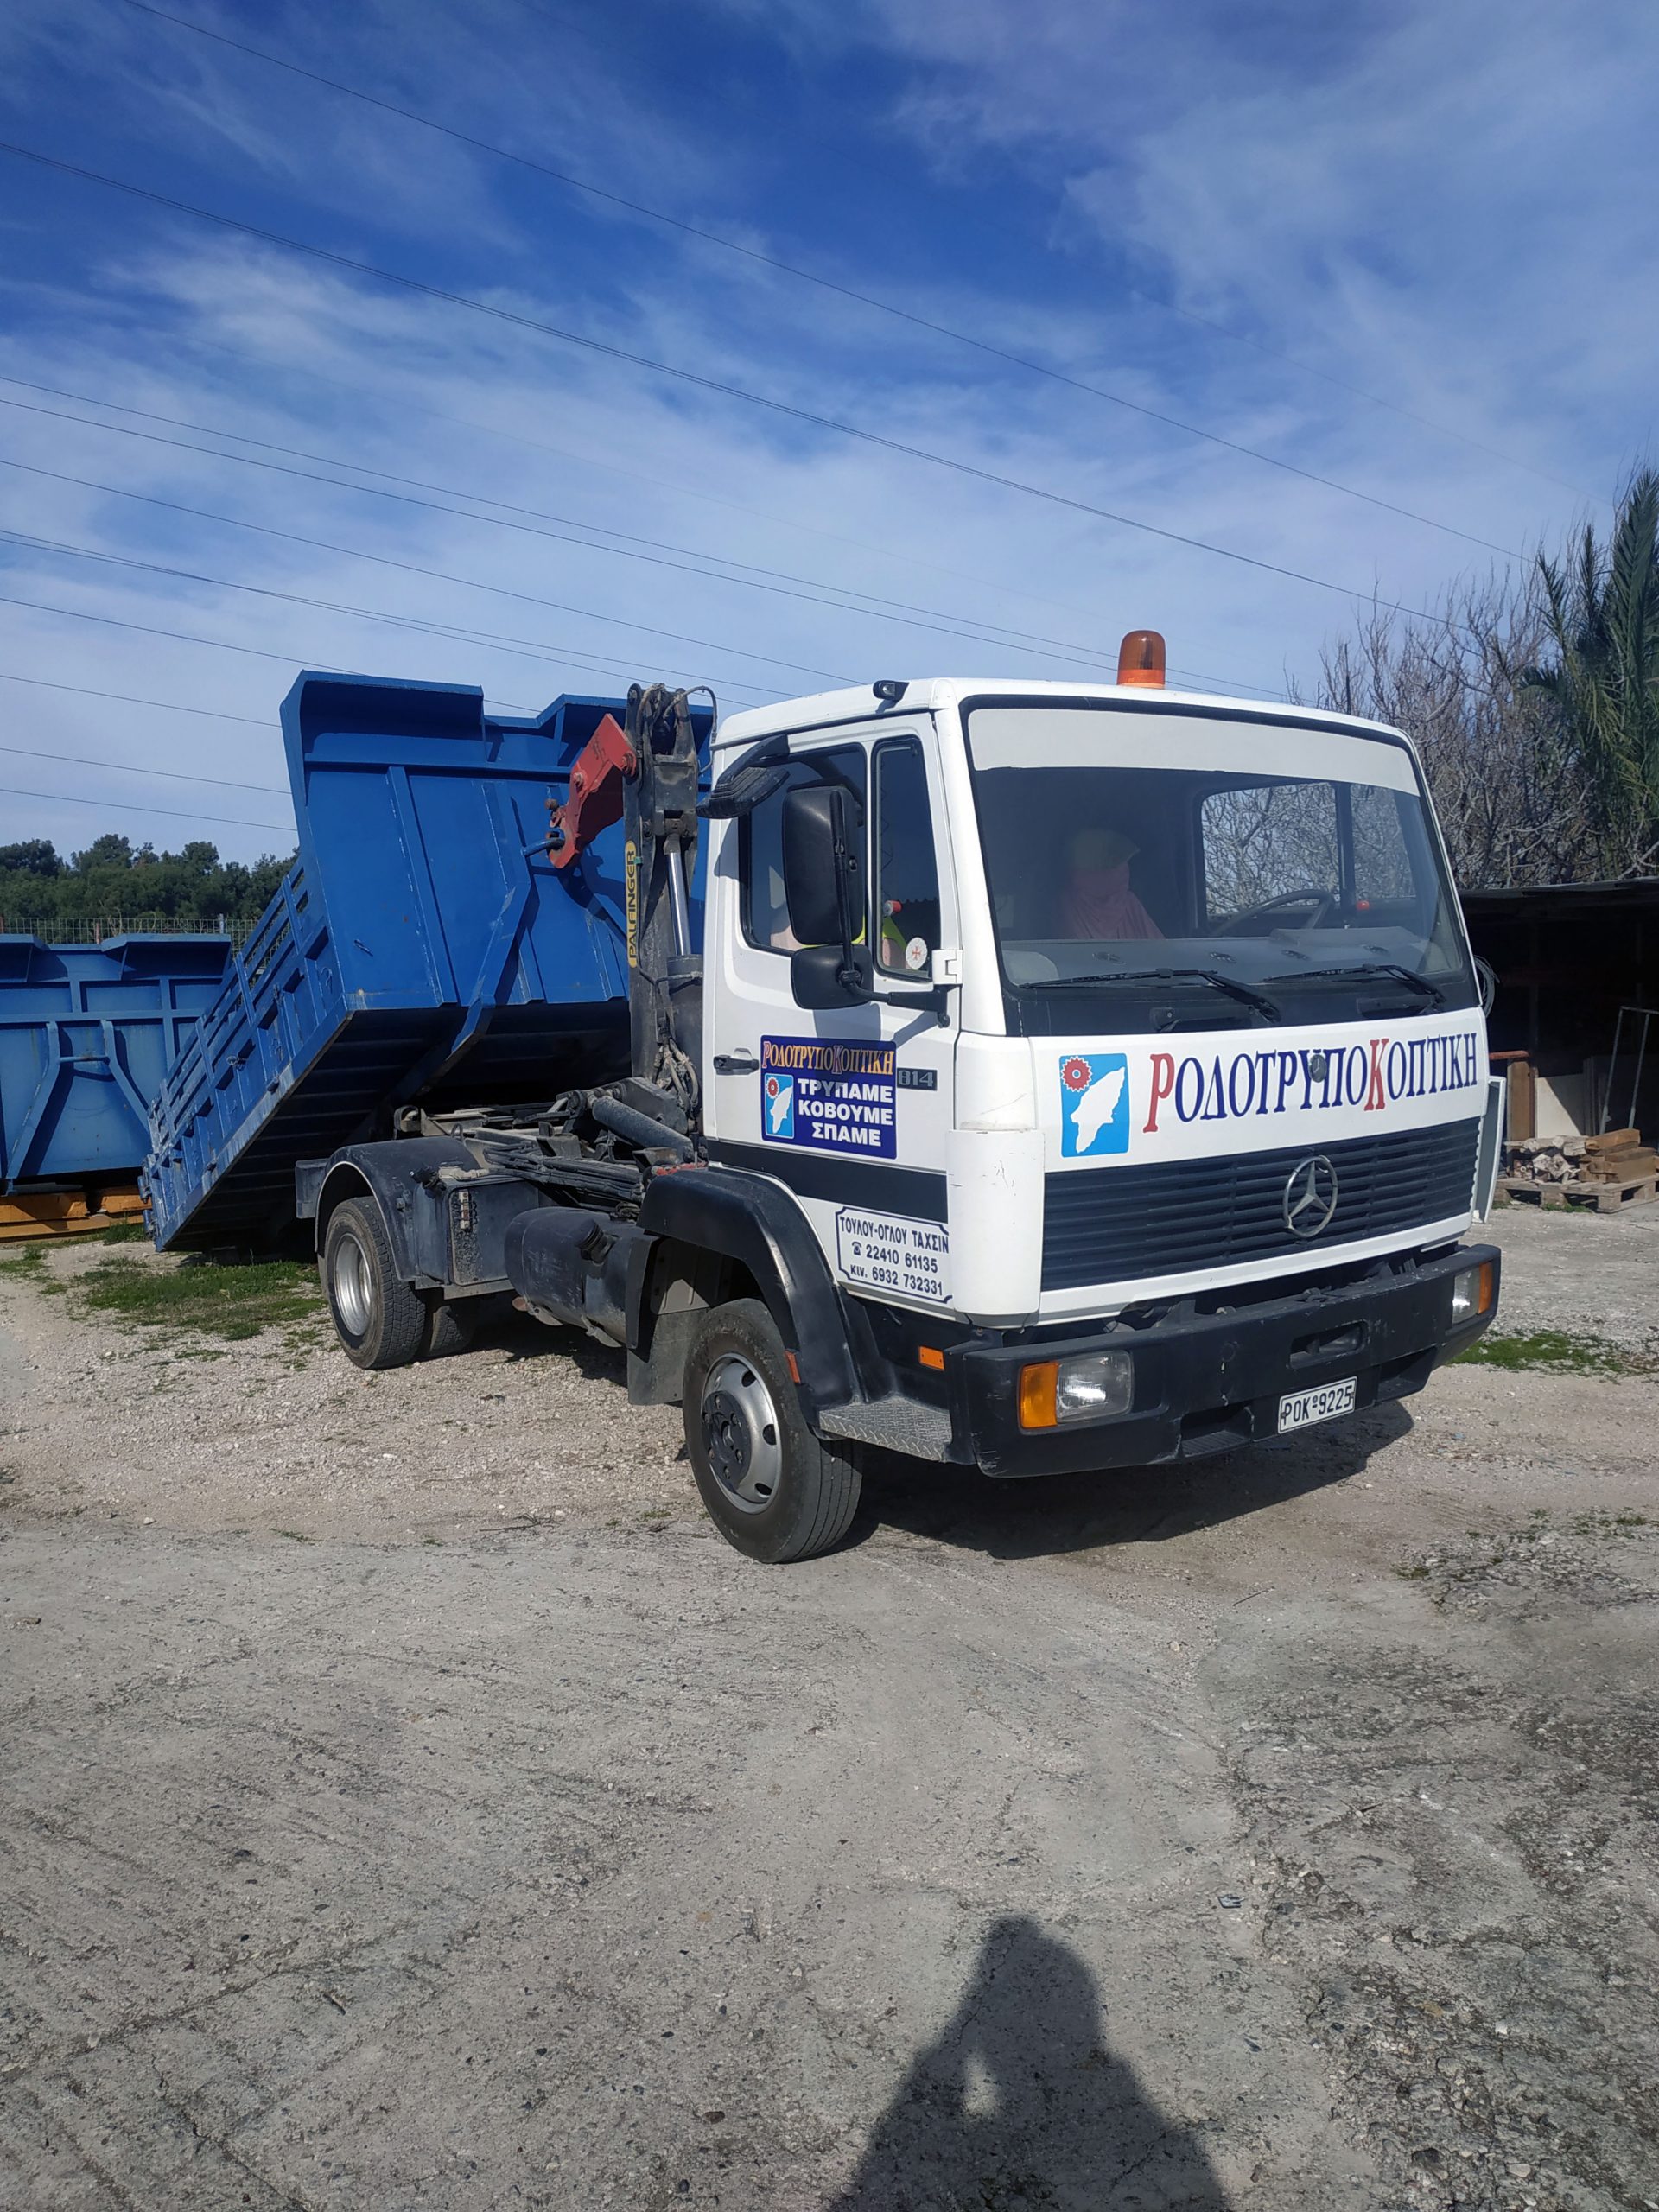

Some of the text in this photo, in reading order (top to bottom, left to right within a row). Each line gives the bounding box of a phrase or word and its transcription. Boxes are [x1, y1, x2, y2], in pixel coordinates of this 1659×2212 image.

[626, 850, 637, 959] PALFINGER
[798, 1078, 893, 1103] ΤΡΥΠΑΜΕ
[898, 1070, 934, 1088] 814
[798, 1099, 893, 1126] ΚΟΒΟΥΜΕ
[811, 1122, 881, 1147] ΣΠΑΜΕ
[839, 1216, 950, 1254] ΤΟΥΛΟΥ-ΟΓΛΟΥ ΤΑΧΣΙΝ
[866, 1243, 938, 1274] 22410 61135
[872, 1266, 899, 1286] 6932
[903, 1273, 943, 1296] 732331
